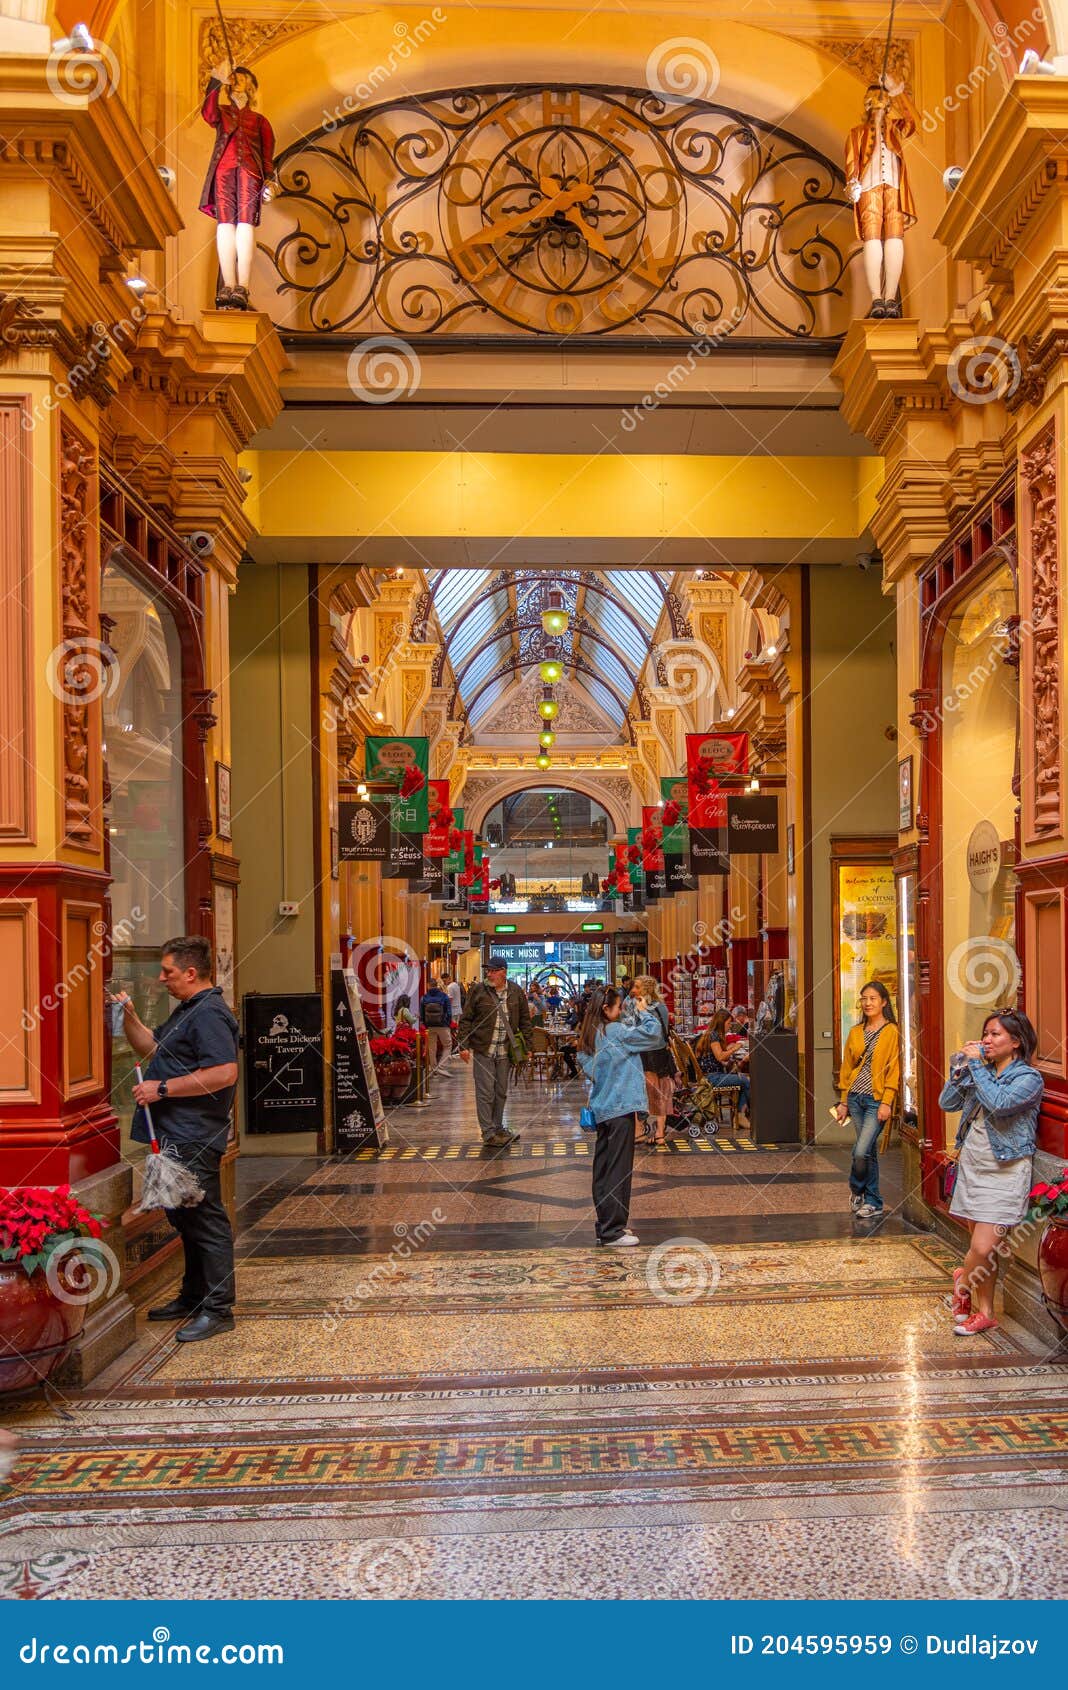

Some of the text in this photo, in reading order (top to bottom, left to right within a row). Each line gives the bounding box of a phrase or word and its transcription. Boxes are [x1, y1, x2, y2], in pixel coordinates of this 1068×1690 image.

[477, 89, 653, 158] THE
[399, 852, 421, 860] Seuss
[969, 847, 998, 867] HAIGH'S
[518, 948, 540, 959] MUSIC
[336, 1025, 353, 1034] Shop
[258, 1035, 288, 1044] Charles
[275, 1045, 305, 1053] Tavern
